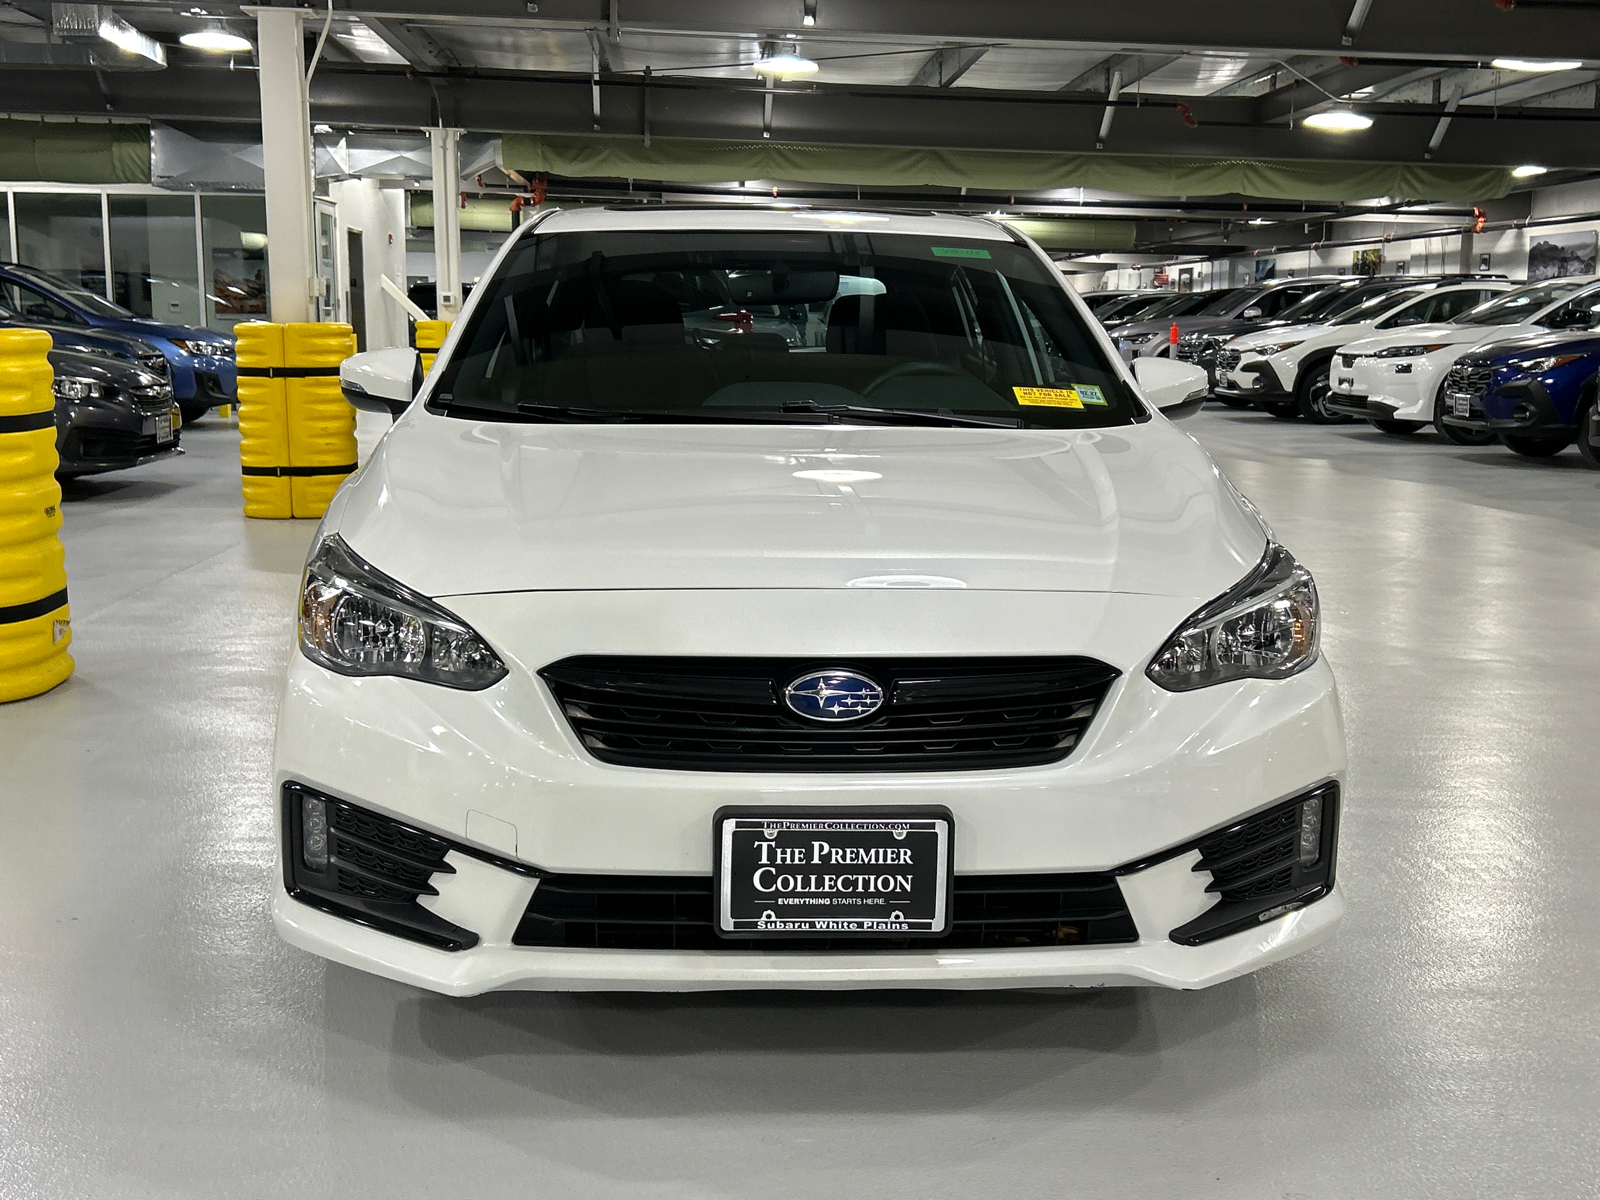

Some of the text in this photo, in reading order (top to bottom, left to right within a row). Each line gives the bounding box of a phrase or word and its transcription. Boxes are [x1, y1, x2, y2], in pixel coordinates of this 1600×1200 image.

[753, 841, 913, 865] THE PREMIER
[752, 866, 913, 893] COLLECTION
[757, 920, 909, 931] Subaru White Plains
